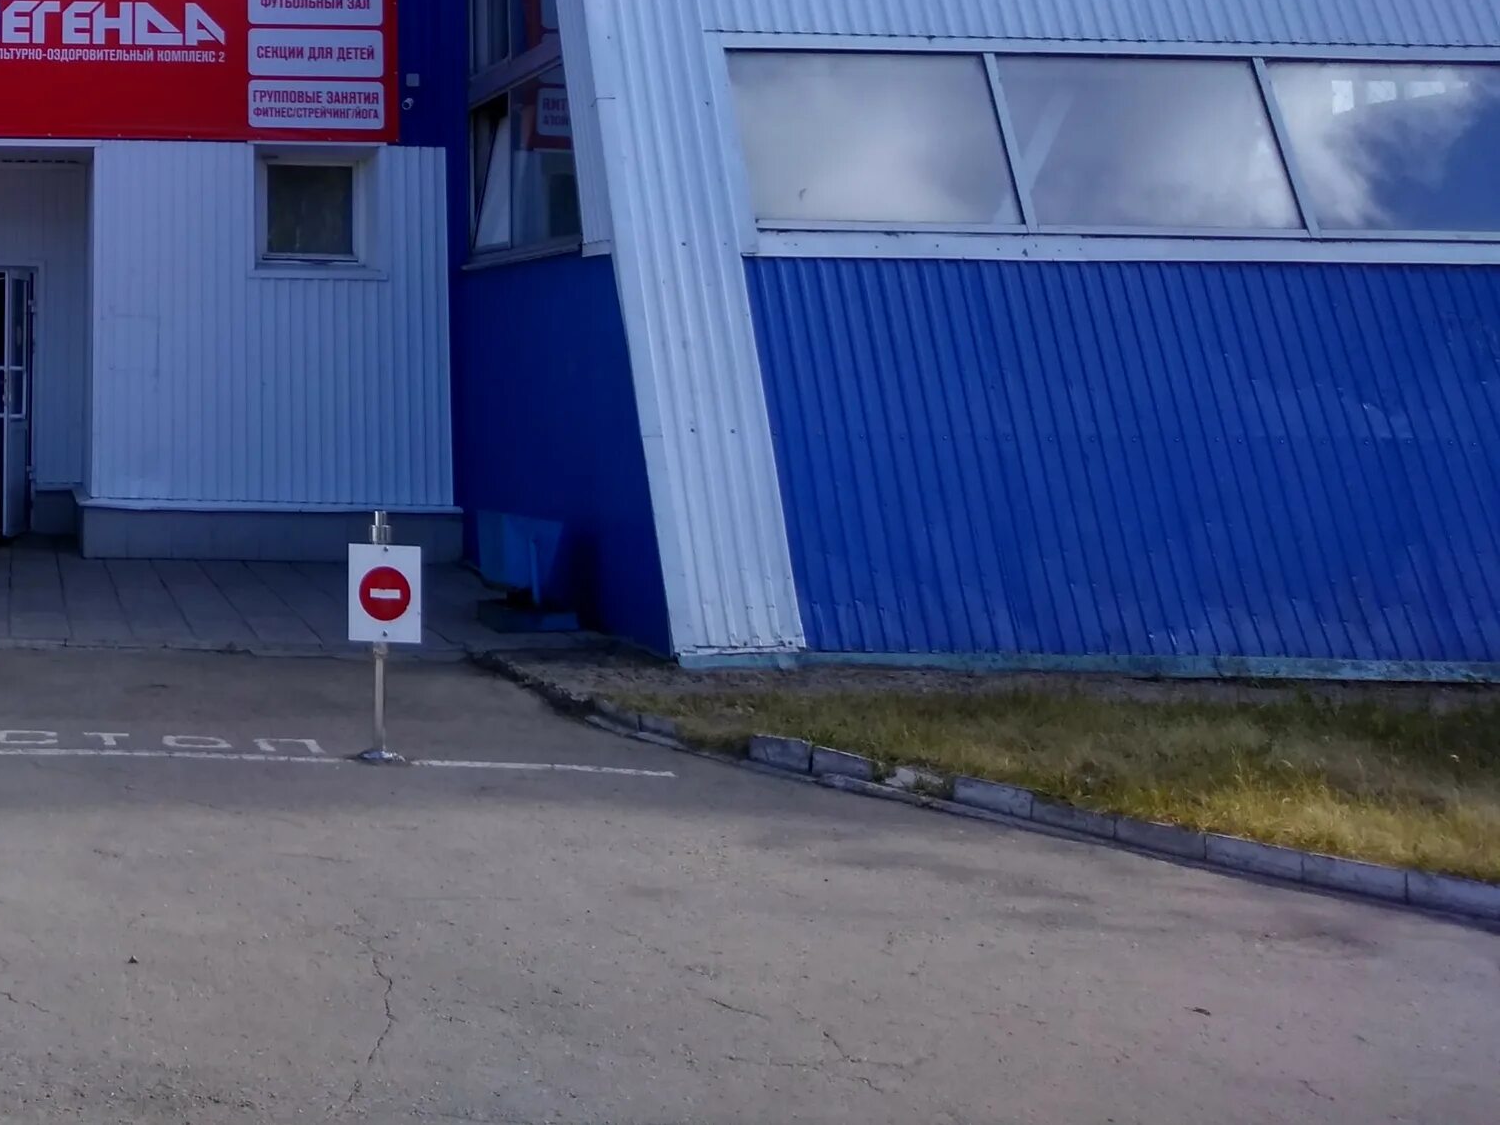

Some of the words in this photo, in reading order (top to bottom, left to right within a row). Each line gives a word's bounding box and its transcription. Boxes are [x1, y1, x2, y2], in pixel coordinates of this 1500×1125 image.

[157, 49, 216, 63] КОМПЛЕКС
[218, 51, 226, 63] 2
[256, 45, 304, 60] СЕКЦИИ
[307, 46, 333, 62] ДЛЯ
[336, 44, 375, 62] ДЕТЕЙ
[252, 90, 323, 103] ГРУППОВЫЕ
[326, 91, 380, 105] ЗАНЯТИЯ
